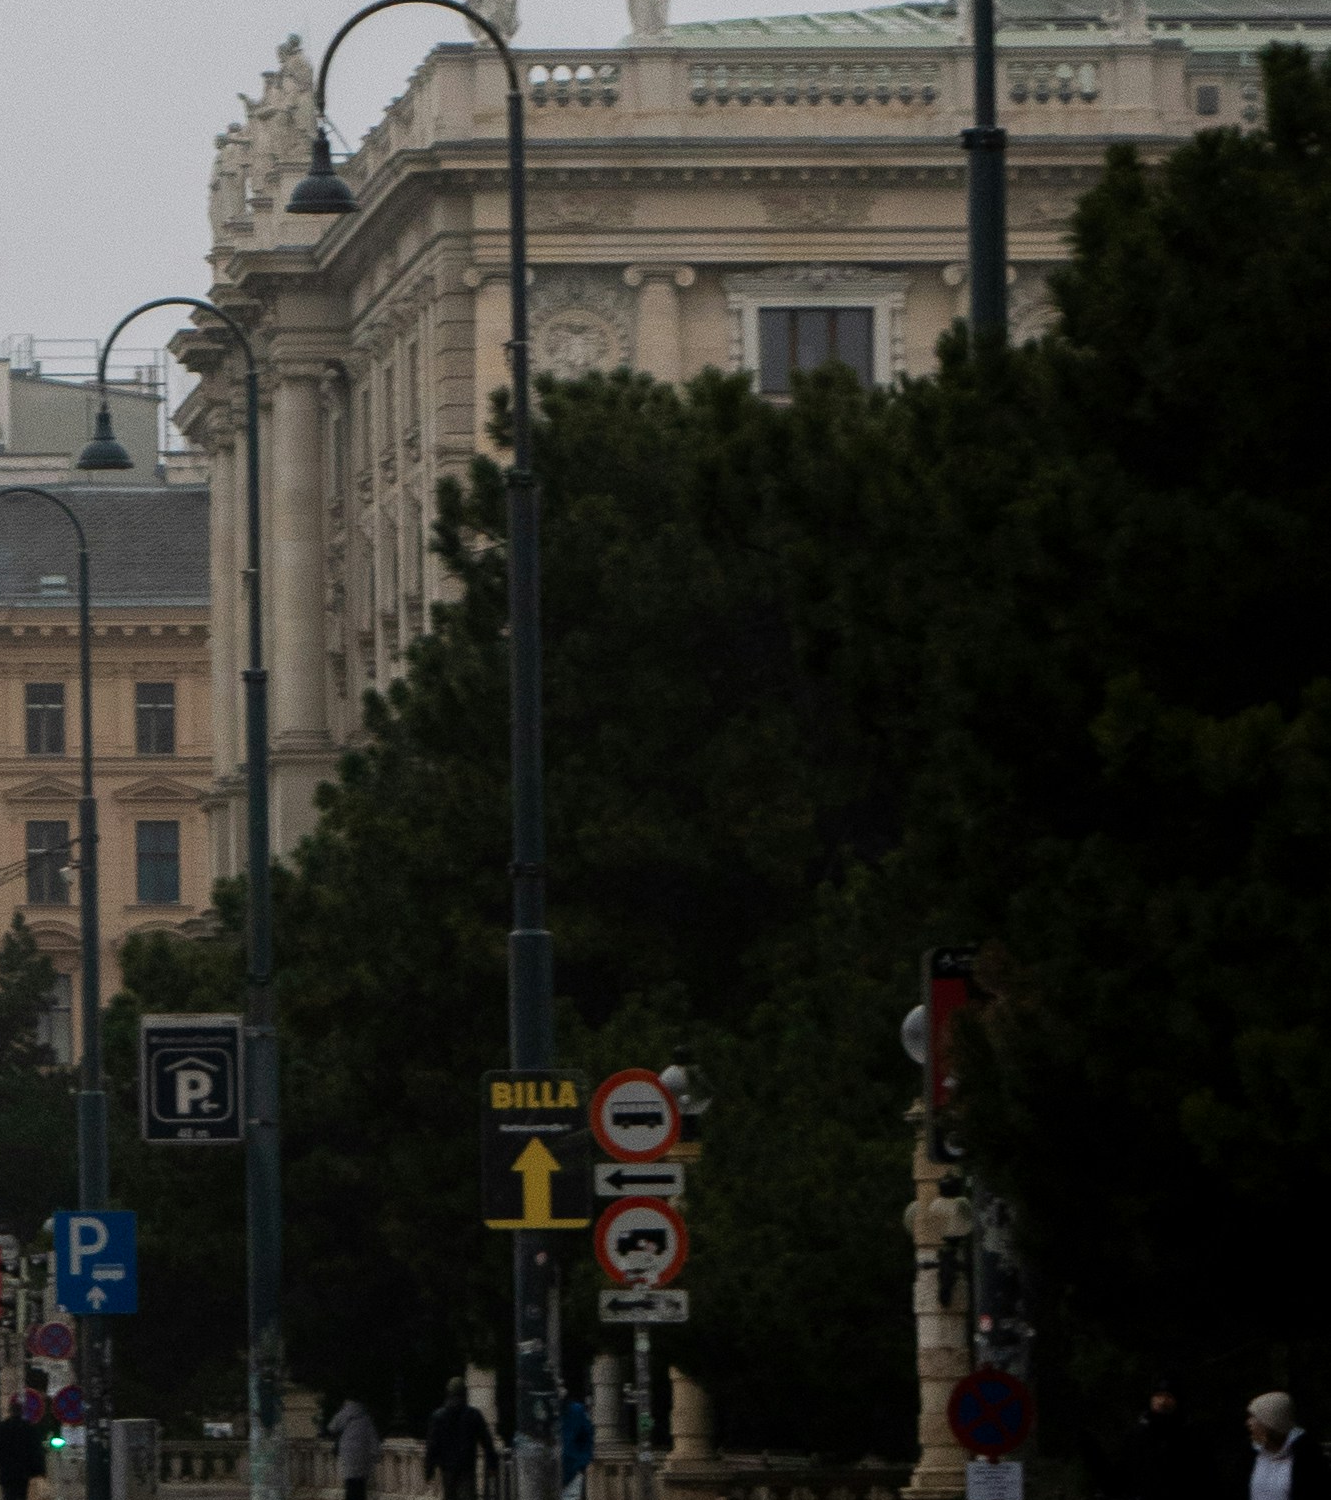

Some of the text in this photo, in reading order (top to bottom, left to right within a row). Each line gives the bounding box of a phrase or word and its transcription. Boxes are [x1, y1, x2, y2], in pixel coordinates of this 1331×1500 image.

[175, 1069, 213, 1115] P
[490, 1079, 579, 1110] BILLA
[68, 1216, 110, 1275] P
